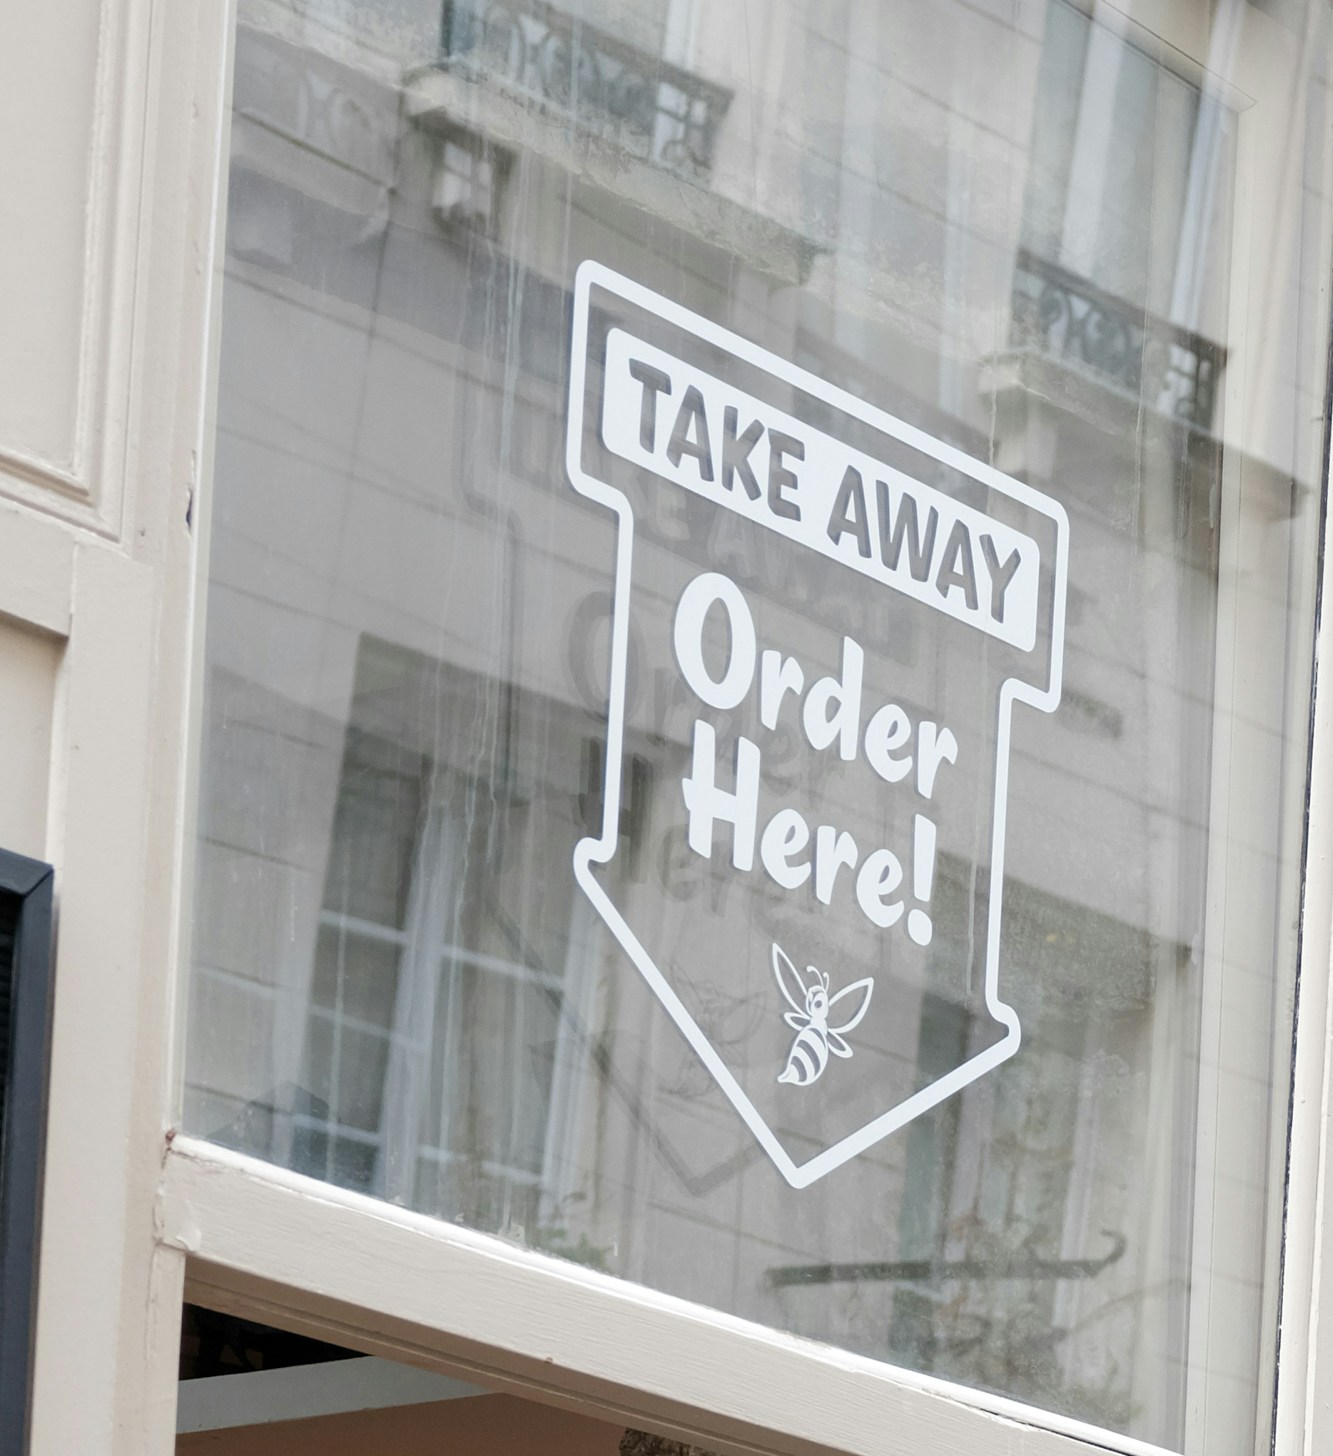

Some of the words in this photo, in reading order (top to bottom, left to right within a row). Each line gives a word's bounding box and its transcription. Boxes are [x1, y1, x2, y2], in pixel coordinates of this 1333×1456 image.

[628, 357, 806, 522] TAKE
[828, 463, 1023, 624] AWAY
[673, 571, 959, 799] Order
[681, 717, 937, 947] Here!
